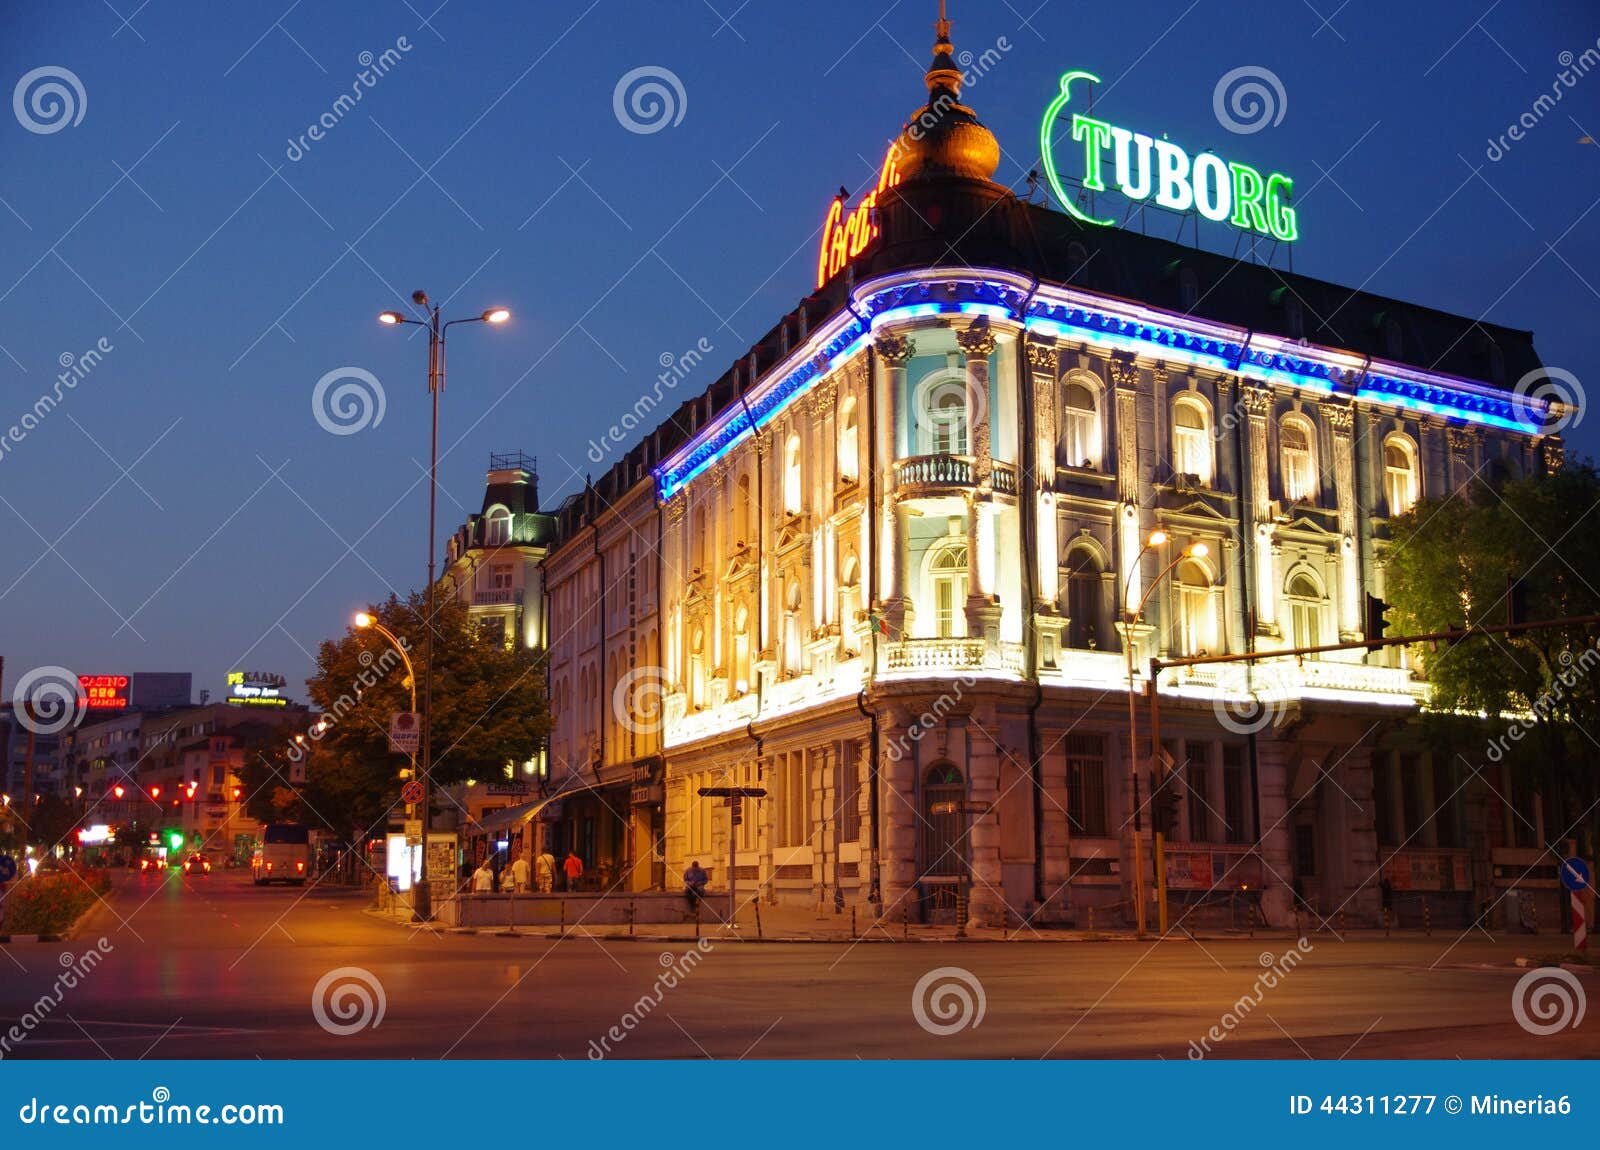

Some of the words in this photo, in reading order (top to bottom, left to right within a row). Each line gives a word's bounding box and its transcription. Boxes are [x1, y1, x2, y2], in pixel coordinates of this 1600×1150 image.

[1072, 113, 1298, 241] TUBORG
[79, 676, 128, 687] CASINO
[487, 783, 529, 793] CHANGE
